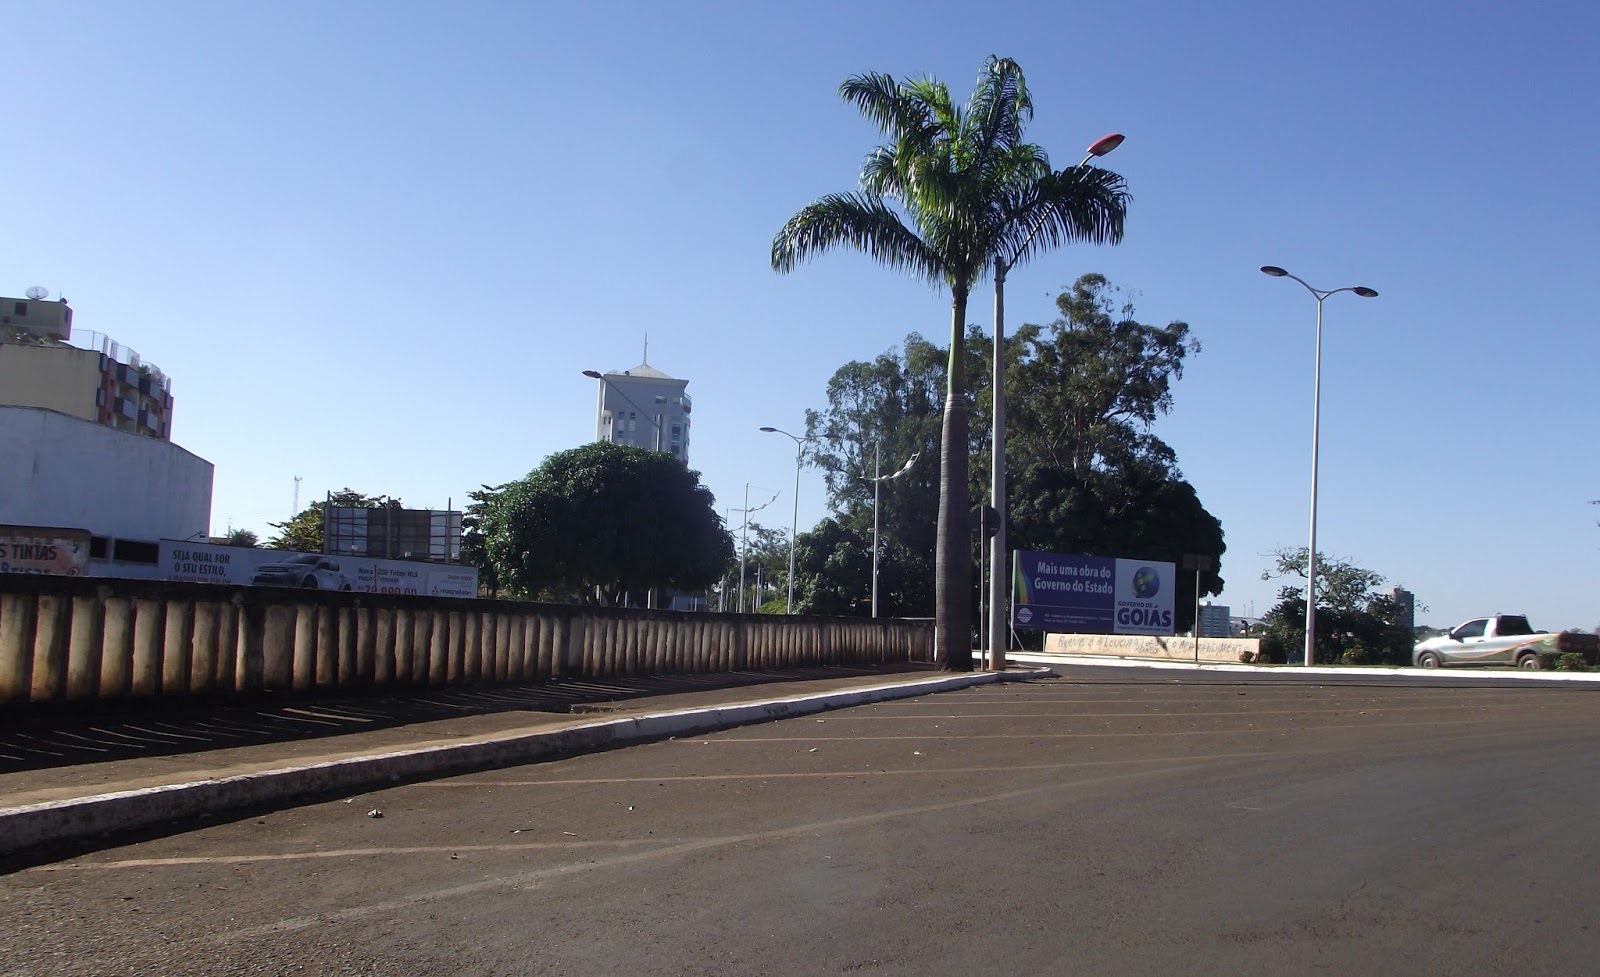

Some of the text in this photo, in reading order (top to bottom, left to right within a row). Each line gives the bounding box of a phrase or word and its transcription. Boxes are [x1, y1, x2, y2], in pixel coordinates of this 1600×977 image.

[11, 544, 57, 561] TINTAS
[173, 550, 230, 564] SEJA QUAL FOR
[174, 563, 226, 577] O SEU ESTILO,
[1037, 561, 1111, 578] Mais uma obra do
[1034, 577, 1113, 594] Governo do Estado
[1117, 605, 1172, 627] GOIÁS
